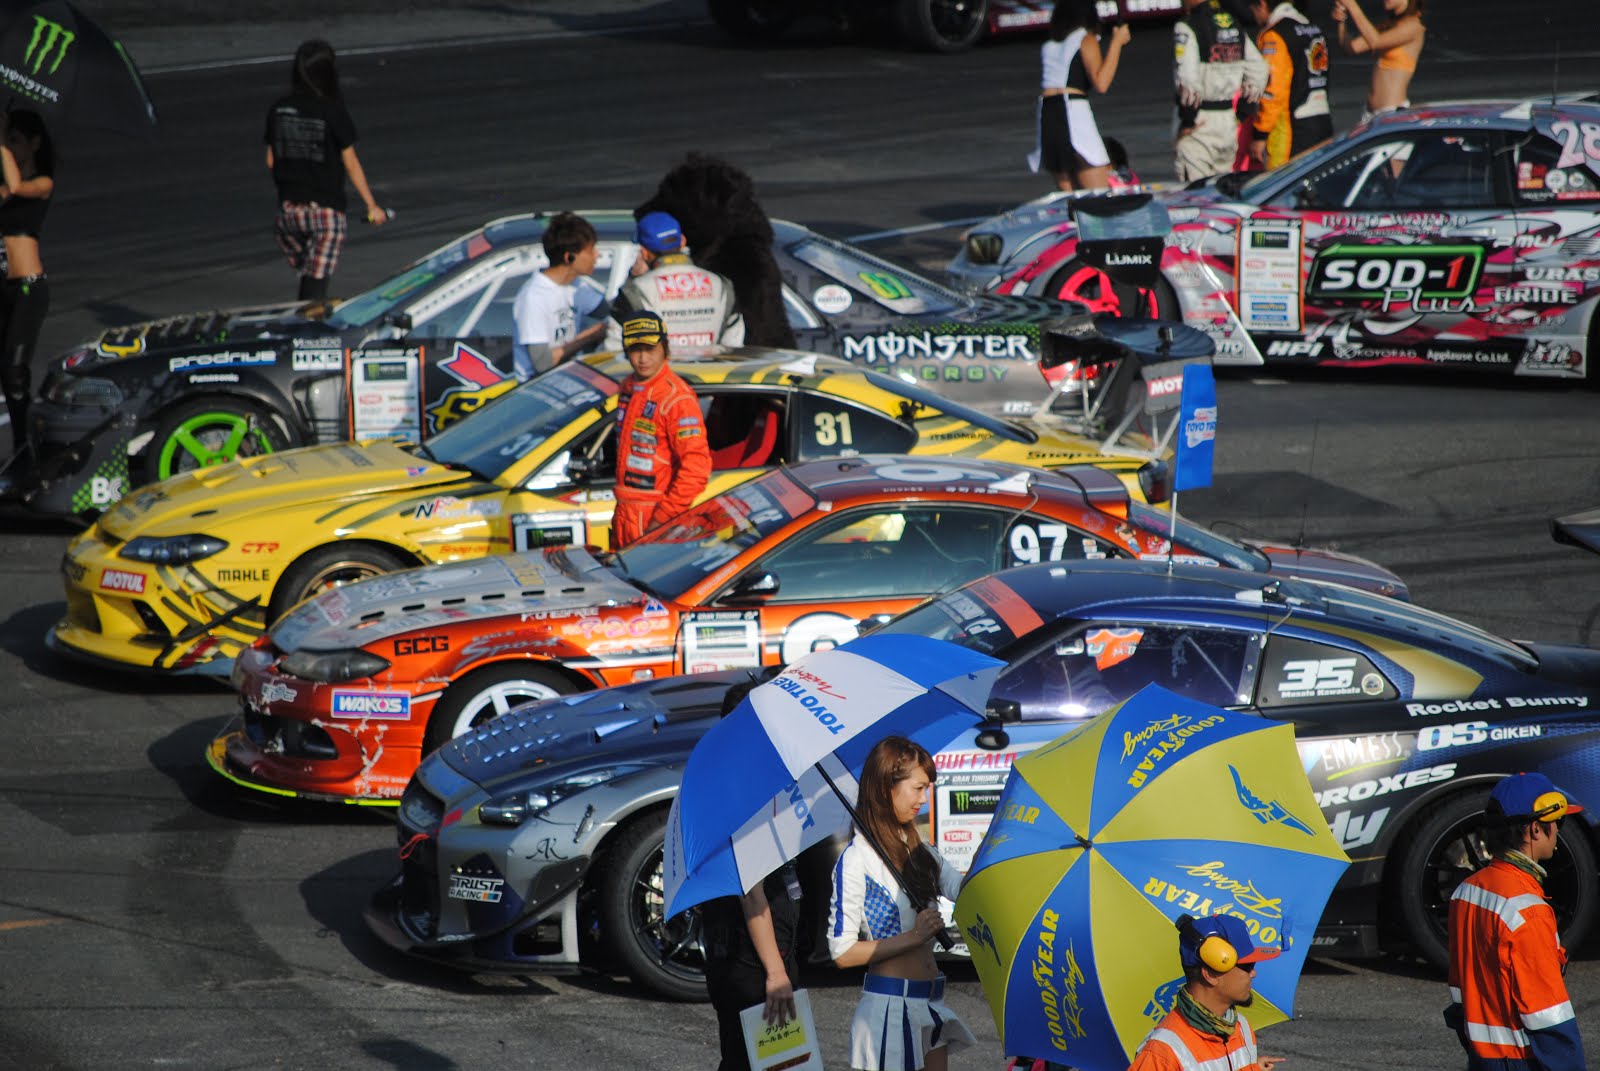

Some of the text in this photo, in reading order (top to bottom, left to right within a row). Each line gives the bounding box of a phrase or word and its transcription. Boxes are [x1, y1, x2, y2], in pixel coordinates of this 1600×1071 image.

[1551, 120, 1600, 169] 28
[1105, 253, 1152, 266] LUMIX
[1321, 256, 1465, 290] SOD-1
[1382, 287, 1492, 313] Plus
[1494, 286, 1578, 304] BRIDE
[843, 331, 1036, 362] MONSTER
[169, 351, 276, 373] prodrive
[814, 411, 852, 445] 31
[1009, 524, 1068, 564] 97
[102, 572, 145, 592] MOTUL
[217, 569, 271, 582] MAHLE
[395, 635, 449, 656] GCG
[1278, 658, 1357, 692] 35
[799, 697, 846, 736] TOYO
[1406, 696, 1589, 717] Rocket Bunny
[1417, 721, 1542, 751] OS GIKEN
[1127, 715, 1226, 788] GOODYEAR
[945, 832, 971, 841] TONE
[451, 890, 482, 900] RACING
[1175, 861, 1283, 919] Racing
[1032, 908, 1067, 1051] GOODYEAR
